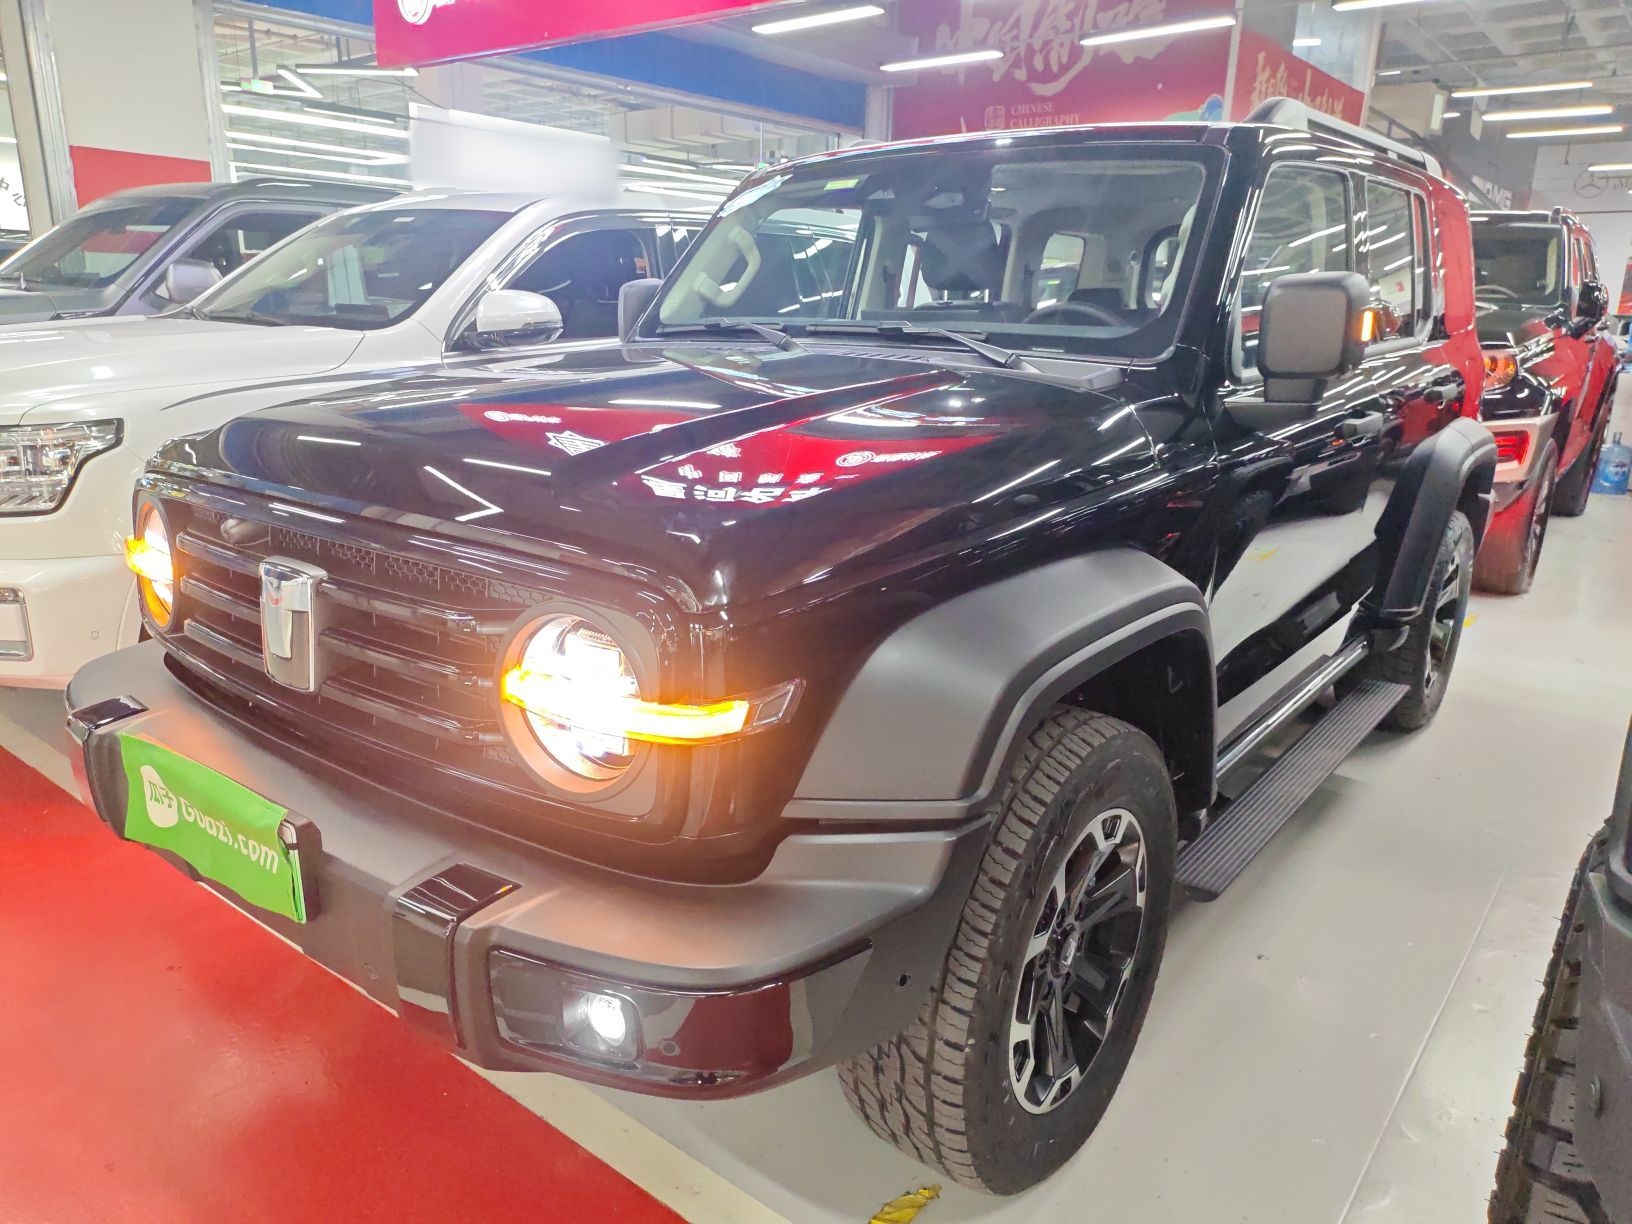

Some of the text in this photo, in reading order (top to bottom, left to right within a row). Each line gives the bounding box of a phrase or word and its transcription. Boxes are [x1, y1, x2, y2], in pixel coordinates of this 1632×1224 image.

[1010, 102, 1055, 116] CHINESE
[1010, 113, 1080, 129] CALLIGRAPHY
[179, 797, 279, 874] Guazi.com
